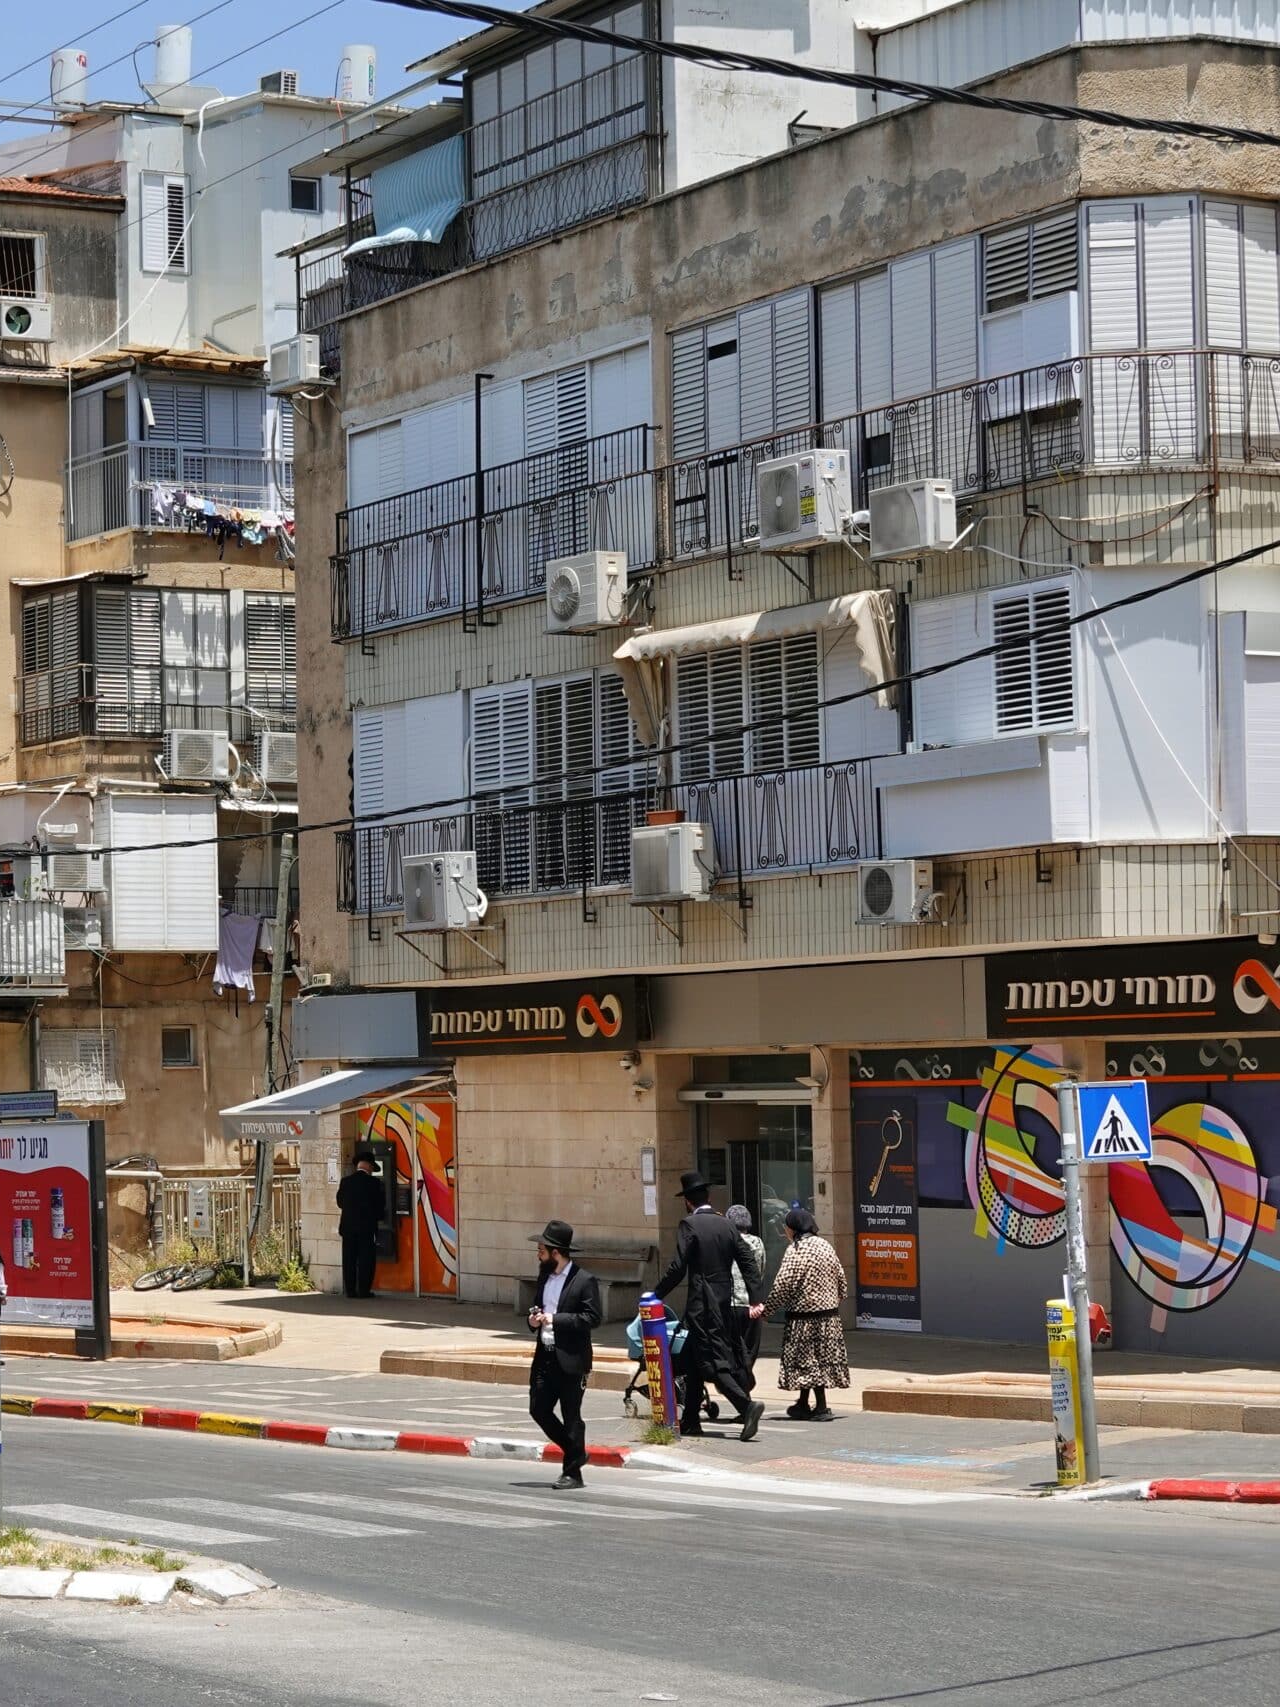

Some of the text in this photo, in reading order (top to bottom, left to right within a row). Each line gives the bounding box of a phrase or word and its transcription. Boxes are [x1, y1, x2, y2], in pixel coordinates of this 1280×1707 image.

[1004, 974, 1217, 1010] מזרחי טפחות
[430, 1006, 566, 1034] מזרחי טפחות
[241, 1122, 287, 1134] מזרחי טפחות
[17, 1136, 27, 1160] לך
